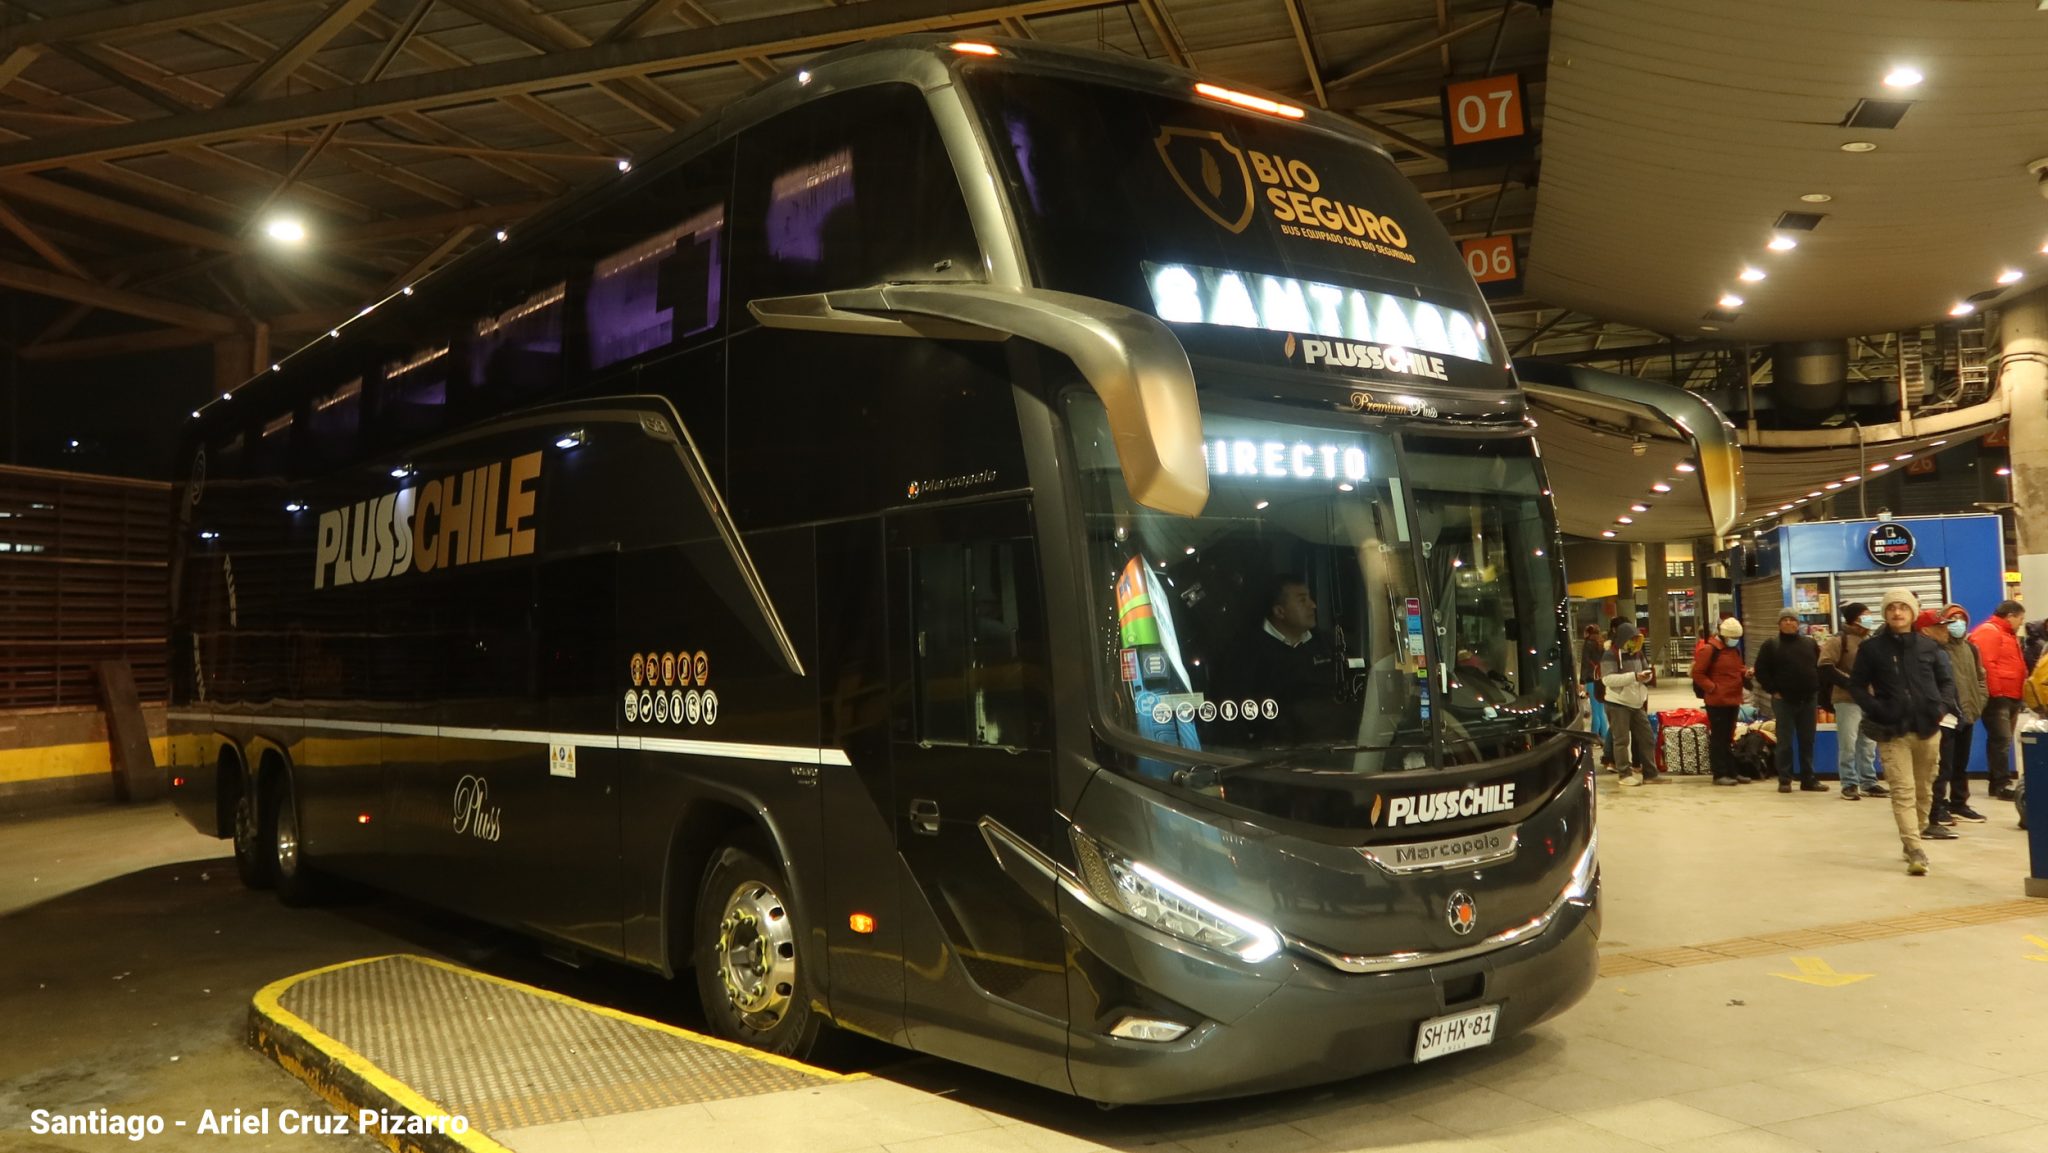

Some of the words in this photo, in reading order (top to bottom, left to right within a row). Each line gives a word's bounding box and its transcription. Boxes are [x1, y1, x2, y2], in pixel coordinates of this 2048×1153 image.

[1457, 90, 1513, 133] 07
[1248, 150, 1320, 193] BIO
[1266, 187, 1408, 249] SEGURO
[1281, 224, 1301, 237] BUS
[1302, 227, 1343, 244] EQUIPADO
[1343, 235, 1362, 249] CON
[1361, 240, 1376, 252] BIO
[1376, 243, 1416, 264] SEGURIDAD
[1467, 246, 1511, 277] 06
[1302, 338, 1449, 382] PLUSSCHILE
[1350, 391, 1408, 415] Premium
[921, 468, 997, 493] Marcopolo
[1203, 439, 1367, 481] IRECTO
[314, 450, 543, 590] PLUSSCHILE
[453, 774, 501, 842] Pluss
[1387, 783, 1516, 828] PLUSSCHILE
[1396, 834, 1501, 863] Marcopolo
